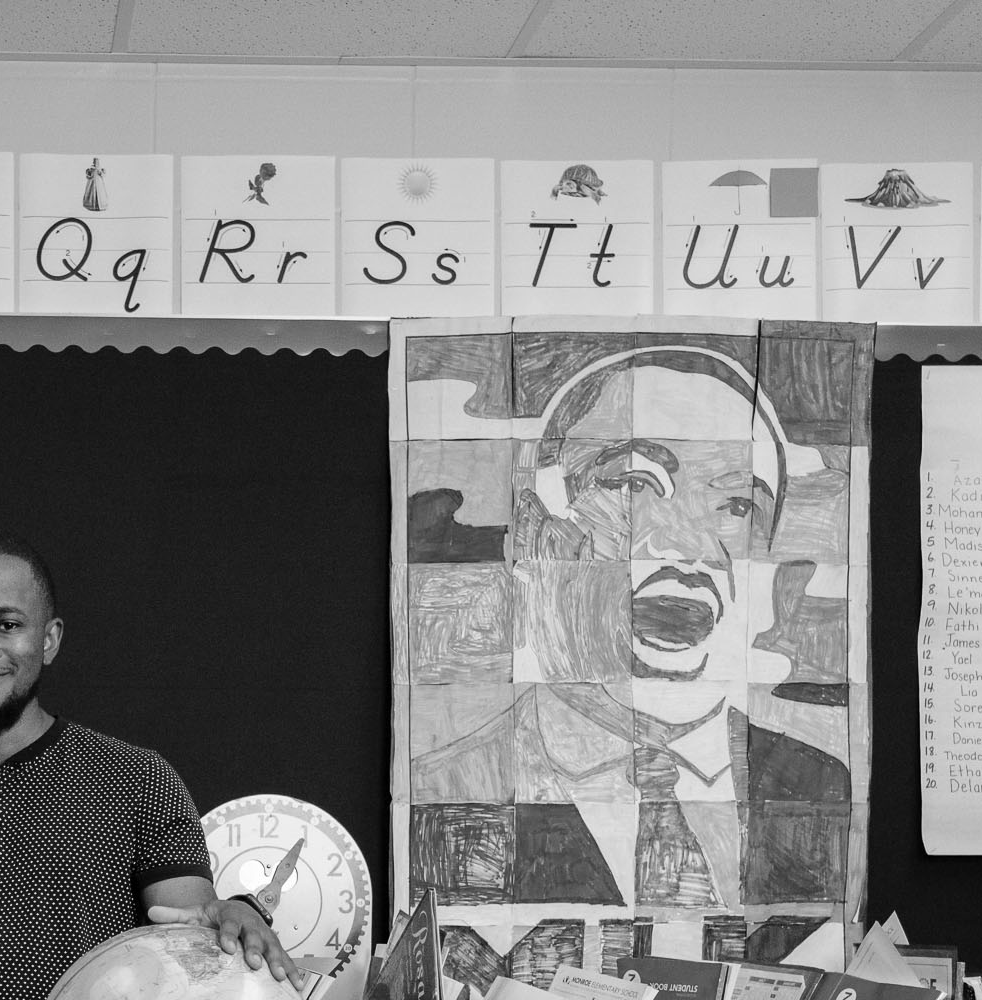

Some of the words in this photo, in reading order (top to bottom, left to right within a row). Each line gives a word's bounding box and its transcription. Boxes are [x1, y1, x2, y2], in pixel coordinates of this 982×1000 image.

[944, 633, 980, 649] James
[226, 823, 241, 847] 11
[258, 814, 279, 838] 12
[326, 852, 343, 877] 2
[338, 889, 354, 914] 3
[325, 927, 342, 951] 4
[572, 976, 593, 988] MONROE
[591, 981, 621, 994] ELEMENTARY
[622, 988, 639, 999] SCHOOL
[669, 984, 699, 993] STUDENT
